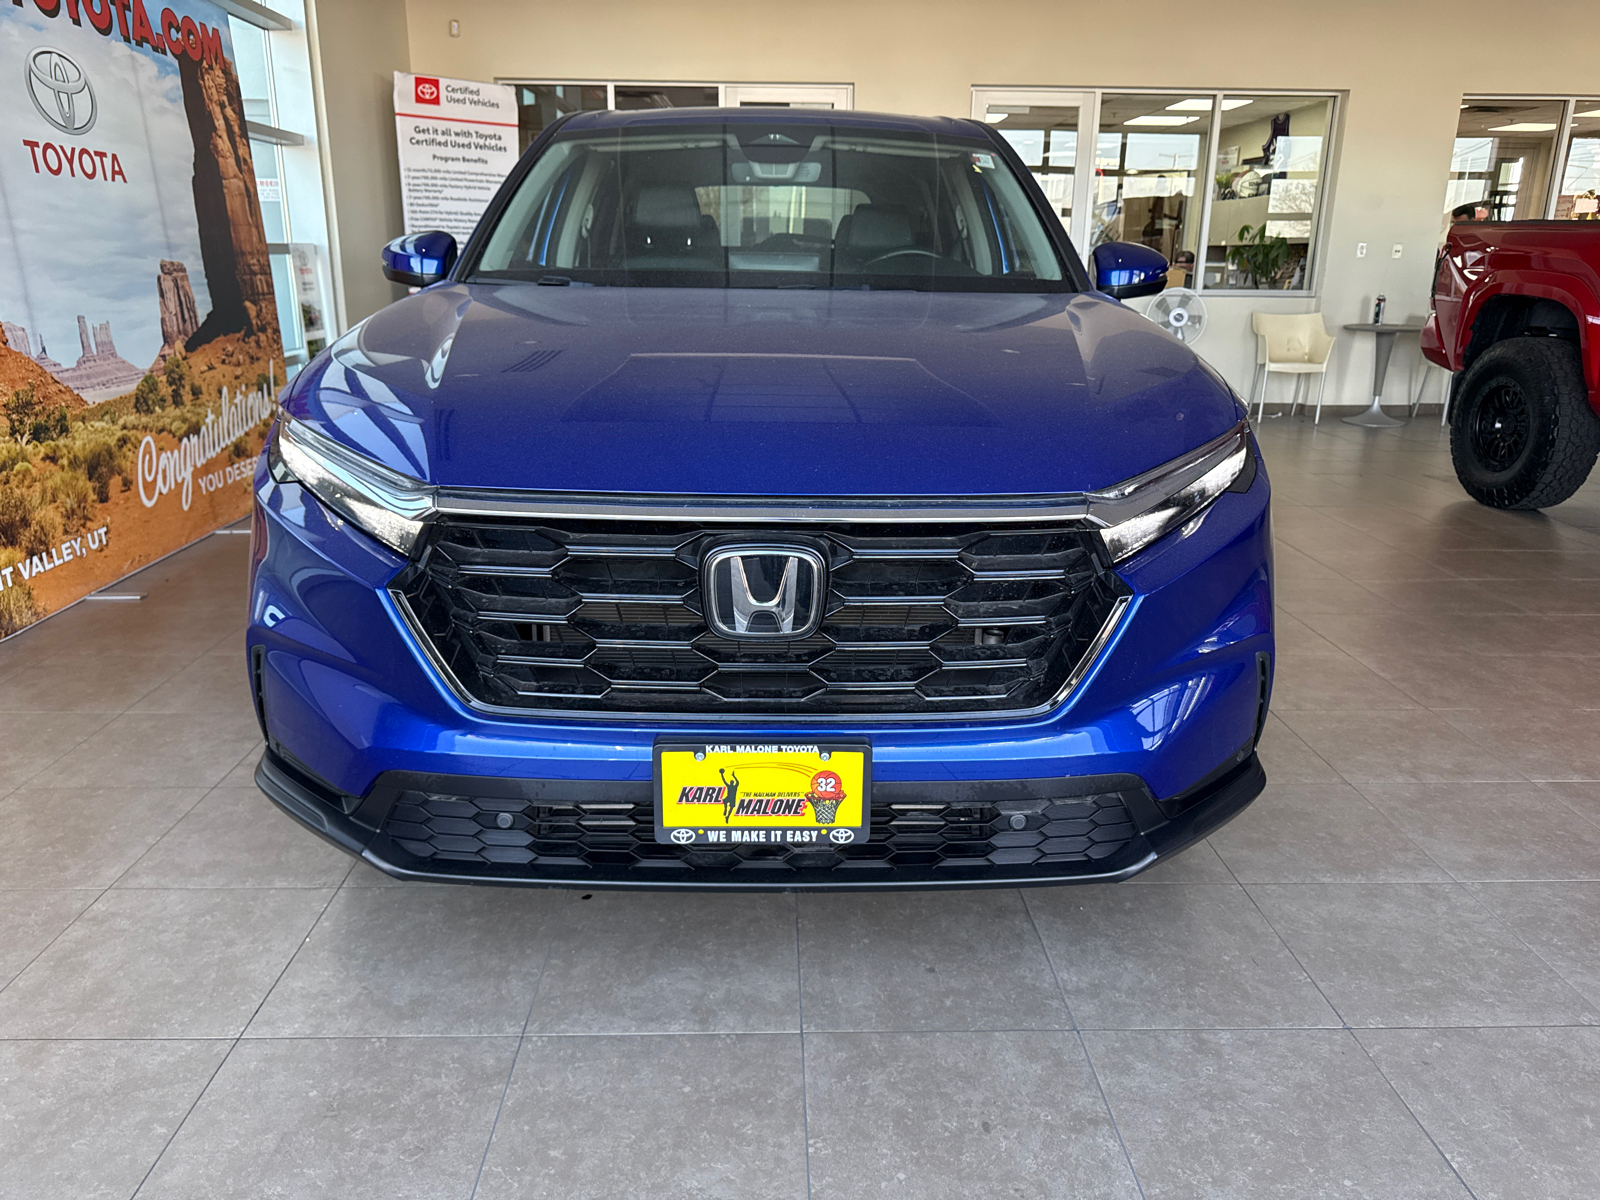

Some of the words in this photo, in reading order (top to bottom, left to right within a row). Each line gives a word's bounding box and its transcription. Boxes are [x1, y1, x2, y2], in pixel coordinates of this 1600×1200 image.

[444, 84, 480, 96] Certified
[445, 95, 467, 105] Used
[467, 97, 500, 109] Vehicles
[413, 125, 431, 135] Get
[432, 126, 439, 136] it
[440, 128, 452, 137] all
[453, 129, 473, 138] with
[474, 131, 502, 142] Toyota
[409, 136, 449, 148] Certified
[449, 140, 473, 150] Used
[473, 141, 507, 153] Vehicles
[22, 138, 128, 184] TOYOTA
[432, 154, 461, 163] Program
[462, 156, 489, 165] Benefits
[137, 357, 277, 511] Congratulations!
[198, 469, 224, 495] YOU
[17, 536, 87, 581] VALLEY,
[87, 526, 108, 550] UT
[705, 744, 734, 754] KARL
[735, 744, 779, 754] MALONE
[780, 744, 820, 754] TOYOTA
[816, 777, 836, 792] 32
[677, 786, 726, 804] KARL
[734, 798, 808, 816] MALONE
[707, 830, 727, 842] WE
[731, 830, 767, 842] MAKE
[770, 830, 783, 842] IT
[786, 830, 819, 842] EASY
